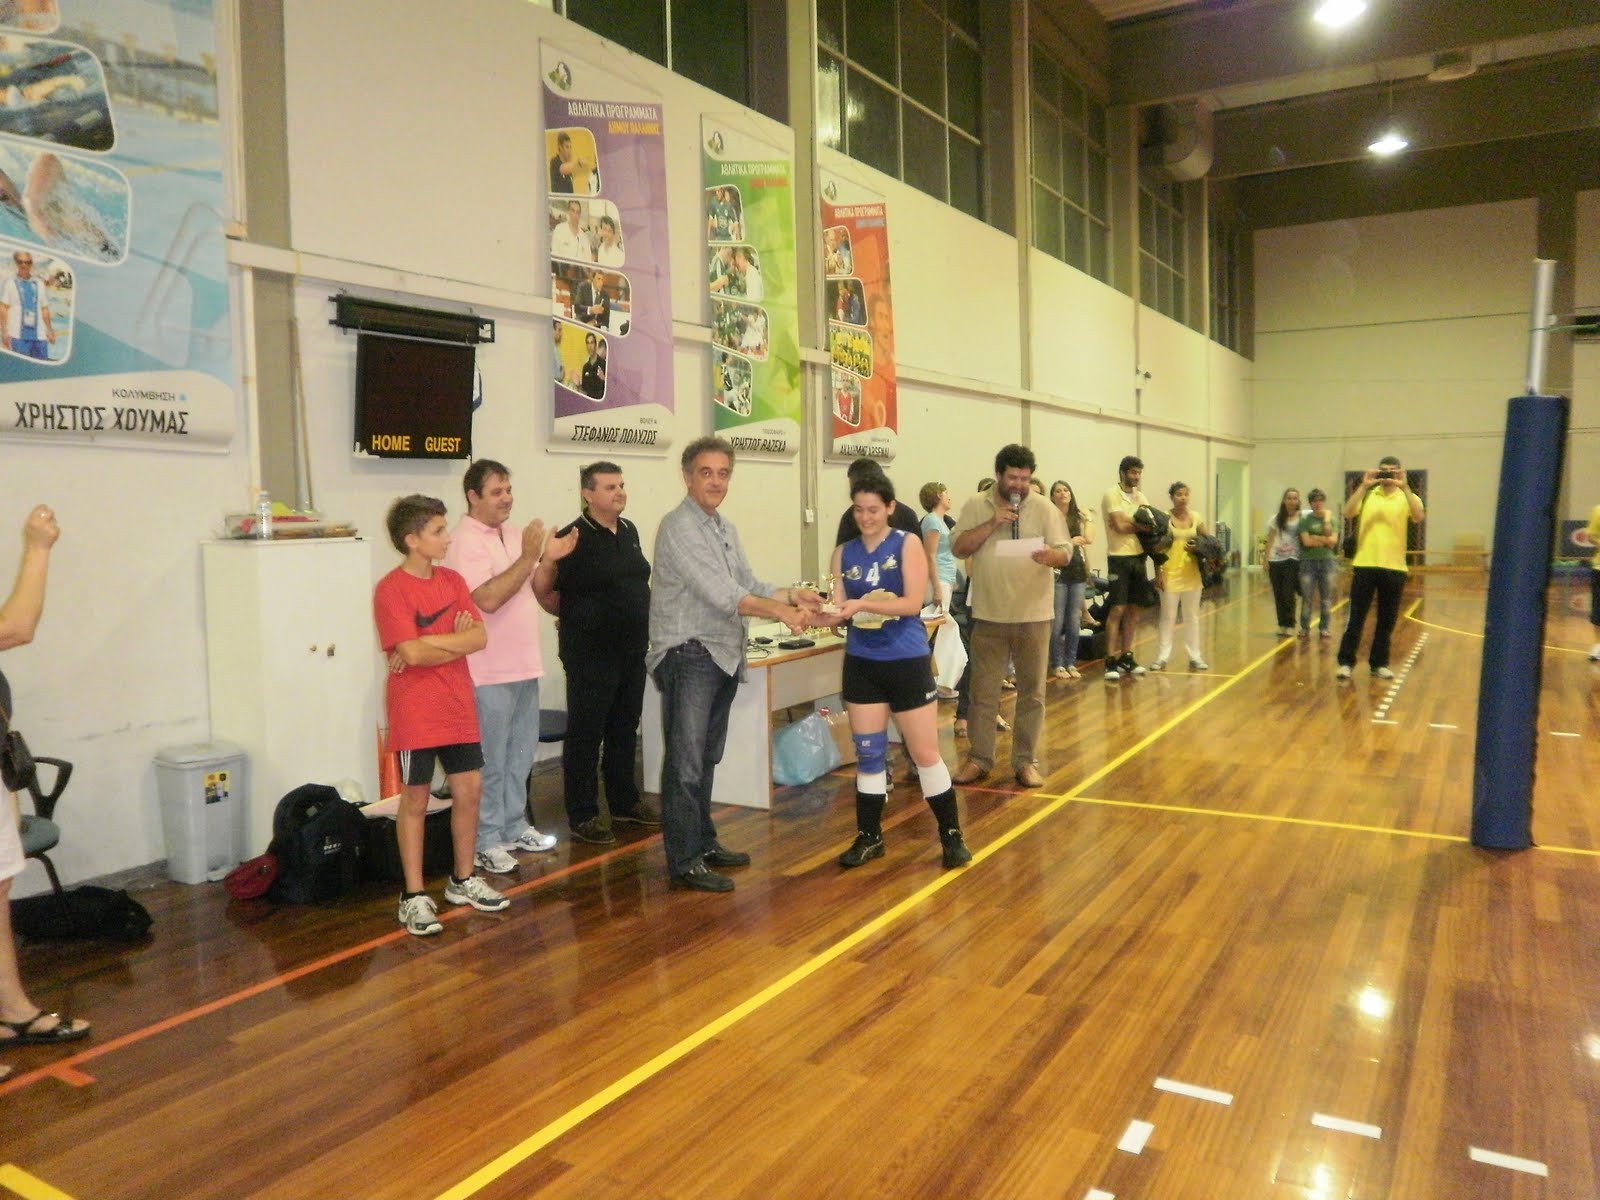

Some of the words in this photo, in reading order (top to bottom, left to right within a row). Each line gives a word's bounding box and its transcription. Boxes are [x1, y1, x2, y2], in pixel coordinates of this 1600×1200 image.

[568, 102, 605, 118] ΑΘΛΗΤΙΚΑ
[606, 104, 658, 120] ΠΡΟΓΡΑΜΜΑΤΑ
[112, 388, 176, 401] ΚΟΛΥΜΒΗΣΗ
[15, 401, 106, 431] ΧΡΗΣΤΟΣ
[109, 406, 190, 434] ΧΟΥΜΑΣ
[372, 435, 411, 451] HOME
[425, 437, 461, 452] GUEST
[571, 425, 620, 442] ΣΤΕΦΑΝΟΣ
[619, 428, 658, 445] ΠΟΛΥΖΟΣ
[865, 561, 880, 586] 4
